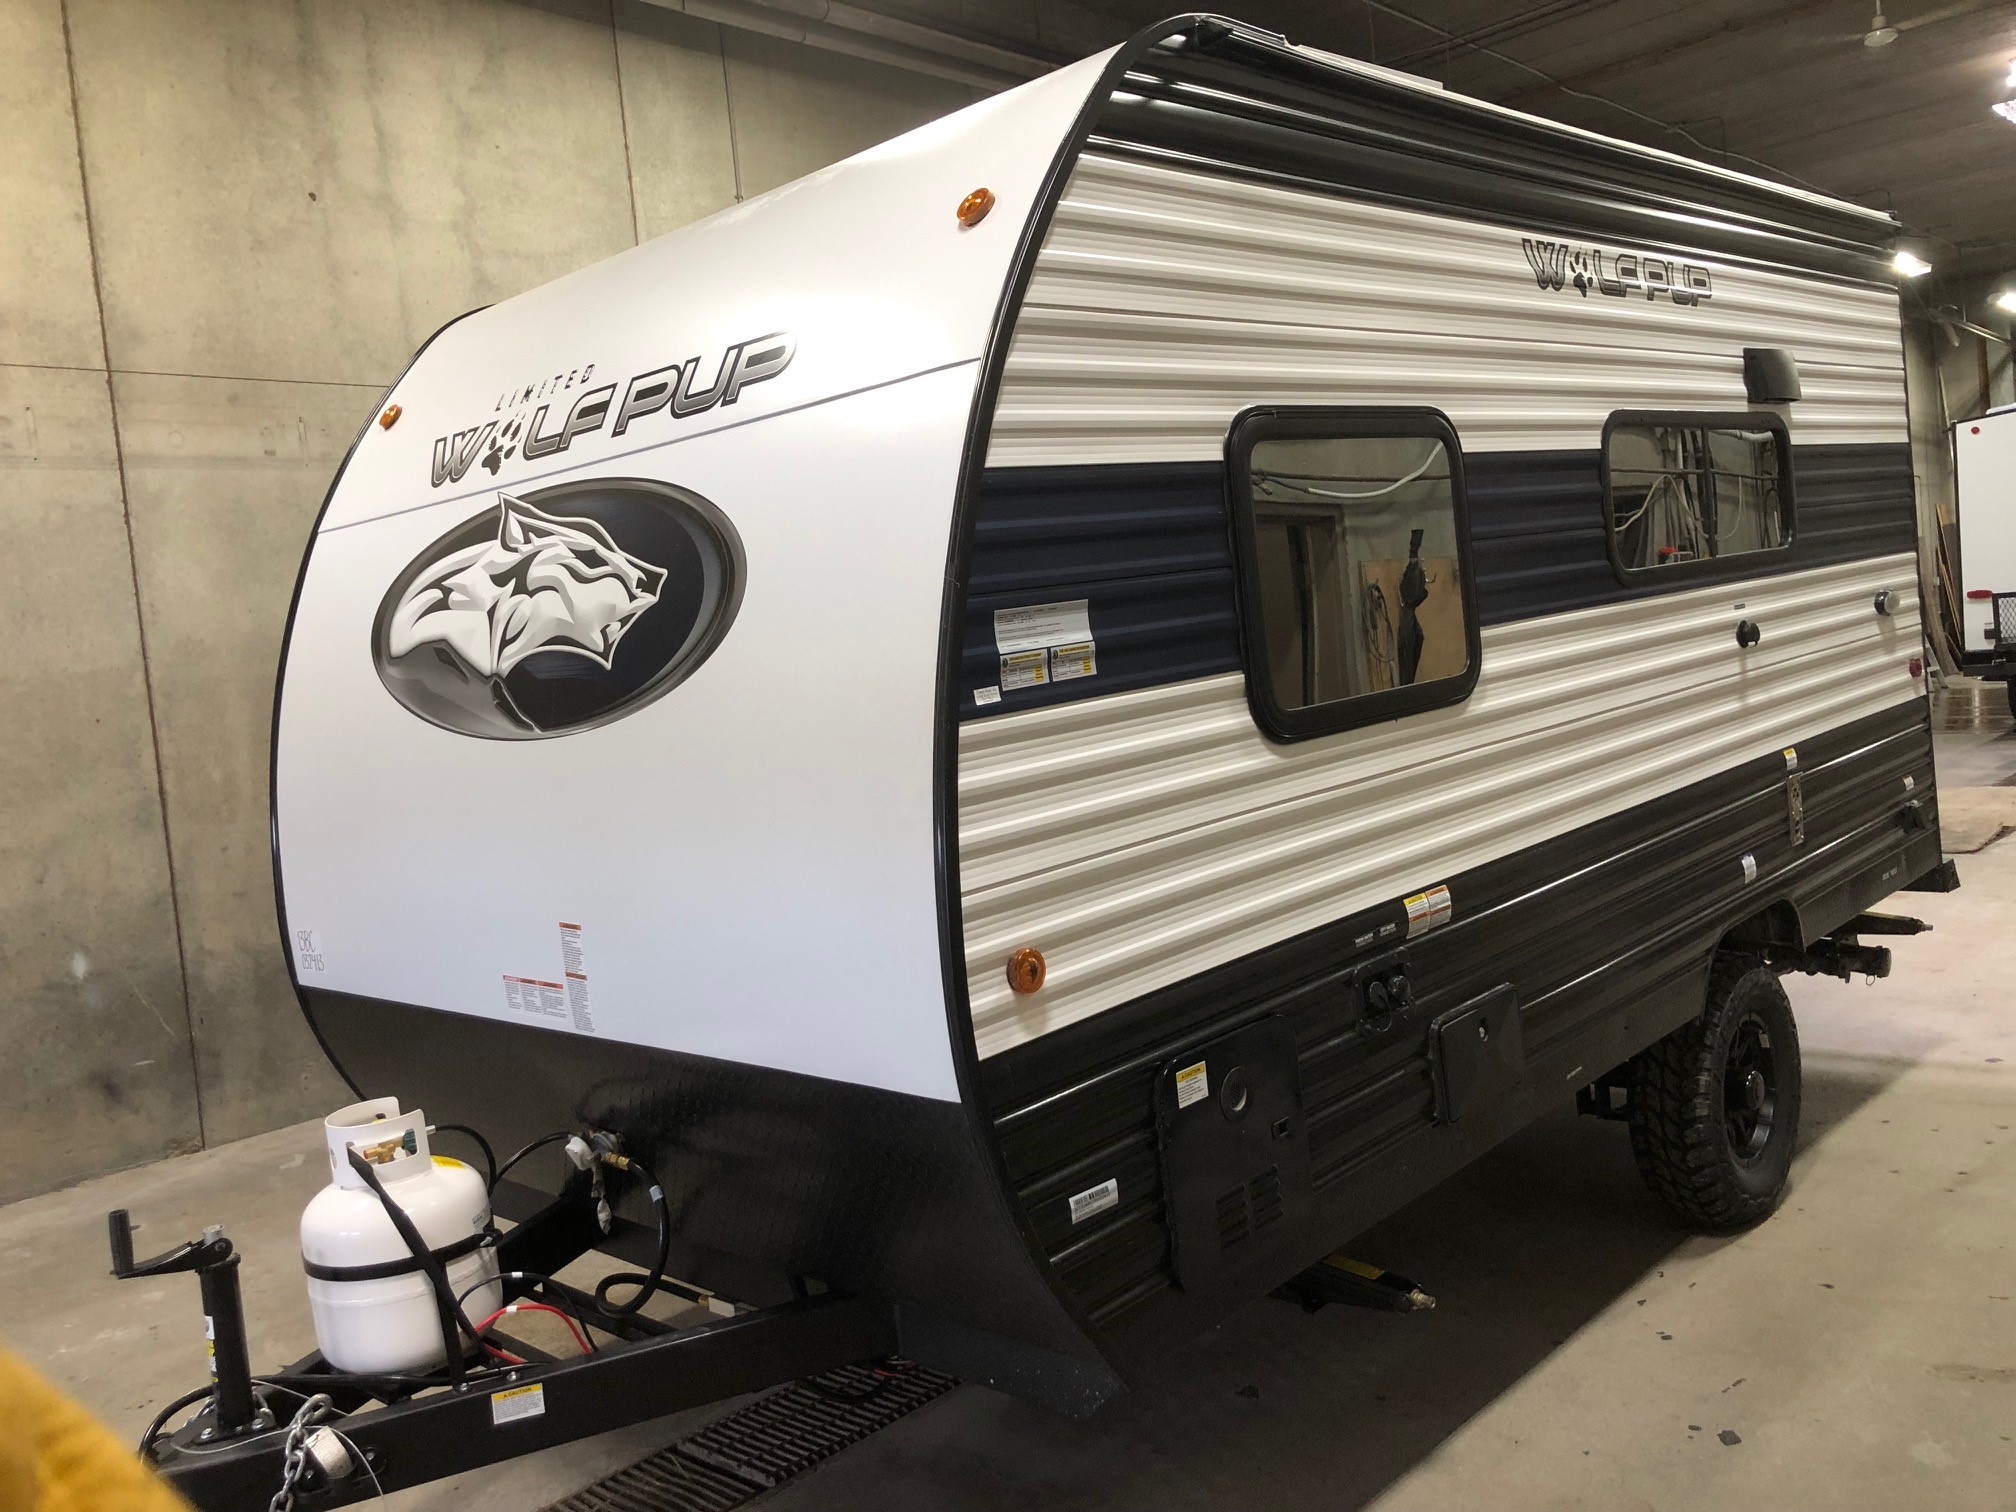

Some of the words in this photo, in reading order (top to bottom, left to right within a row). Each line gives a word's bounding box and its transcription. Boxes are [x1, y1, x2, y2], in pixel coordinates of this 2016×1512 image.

[1643, 257, 1713, 307] PUP
[494, 363, 596, 412] LIMITED
[611, 330, 798, 438] PUP
[508, 1386, 532, 1396] CAUTION
